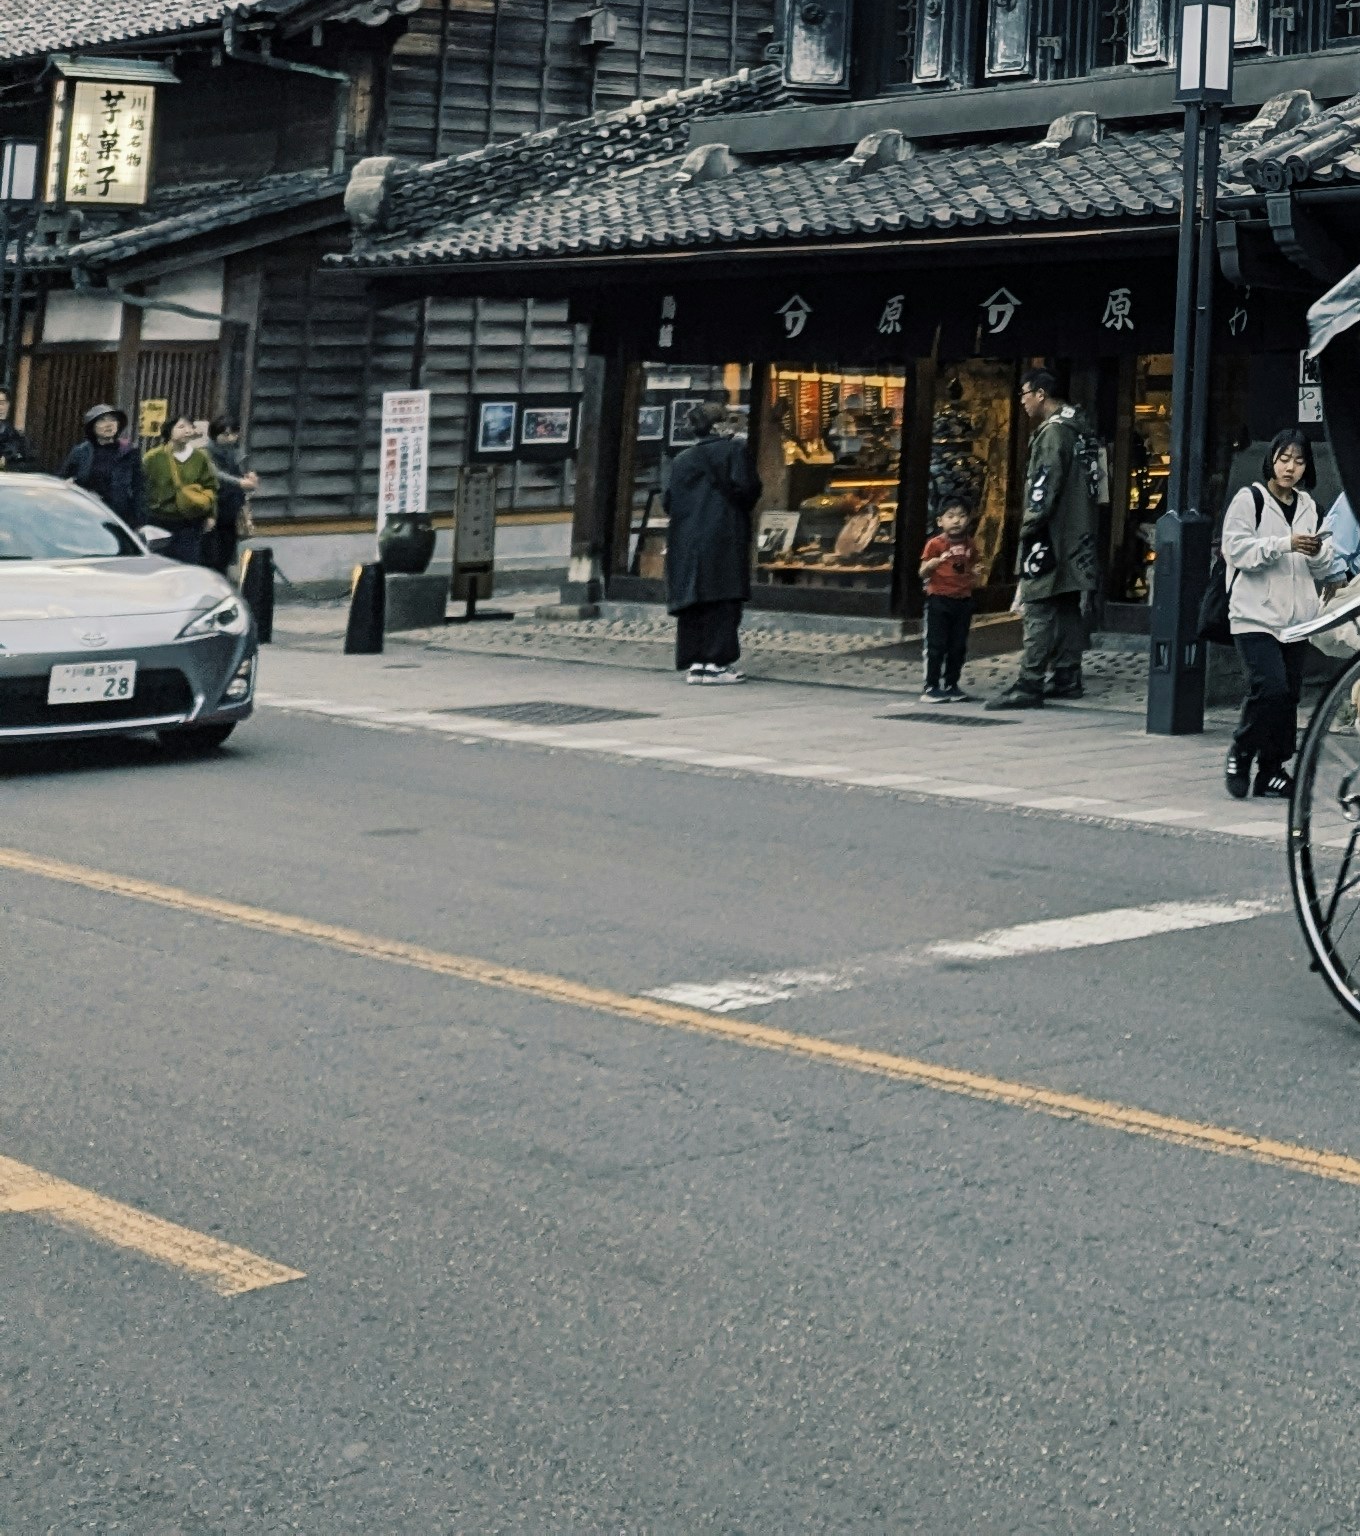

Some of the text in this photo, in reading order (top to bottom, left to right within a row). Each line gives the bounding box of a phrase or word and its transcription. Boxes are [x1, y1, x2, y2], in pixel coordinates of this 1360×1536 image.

[96, 89, 126, 196] 芋菓子
[1100, 286, 1135, 331] 原
[103, 677, 130, 698] 28
